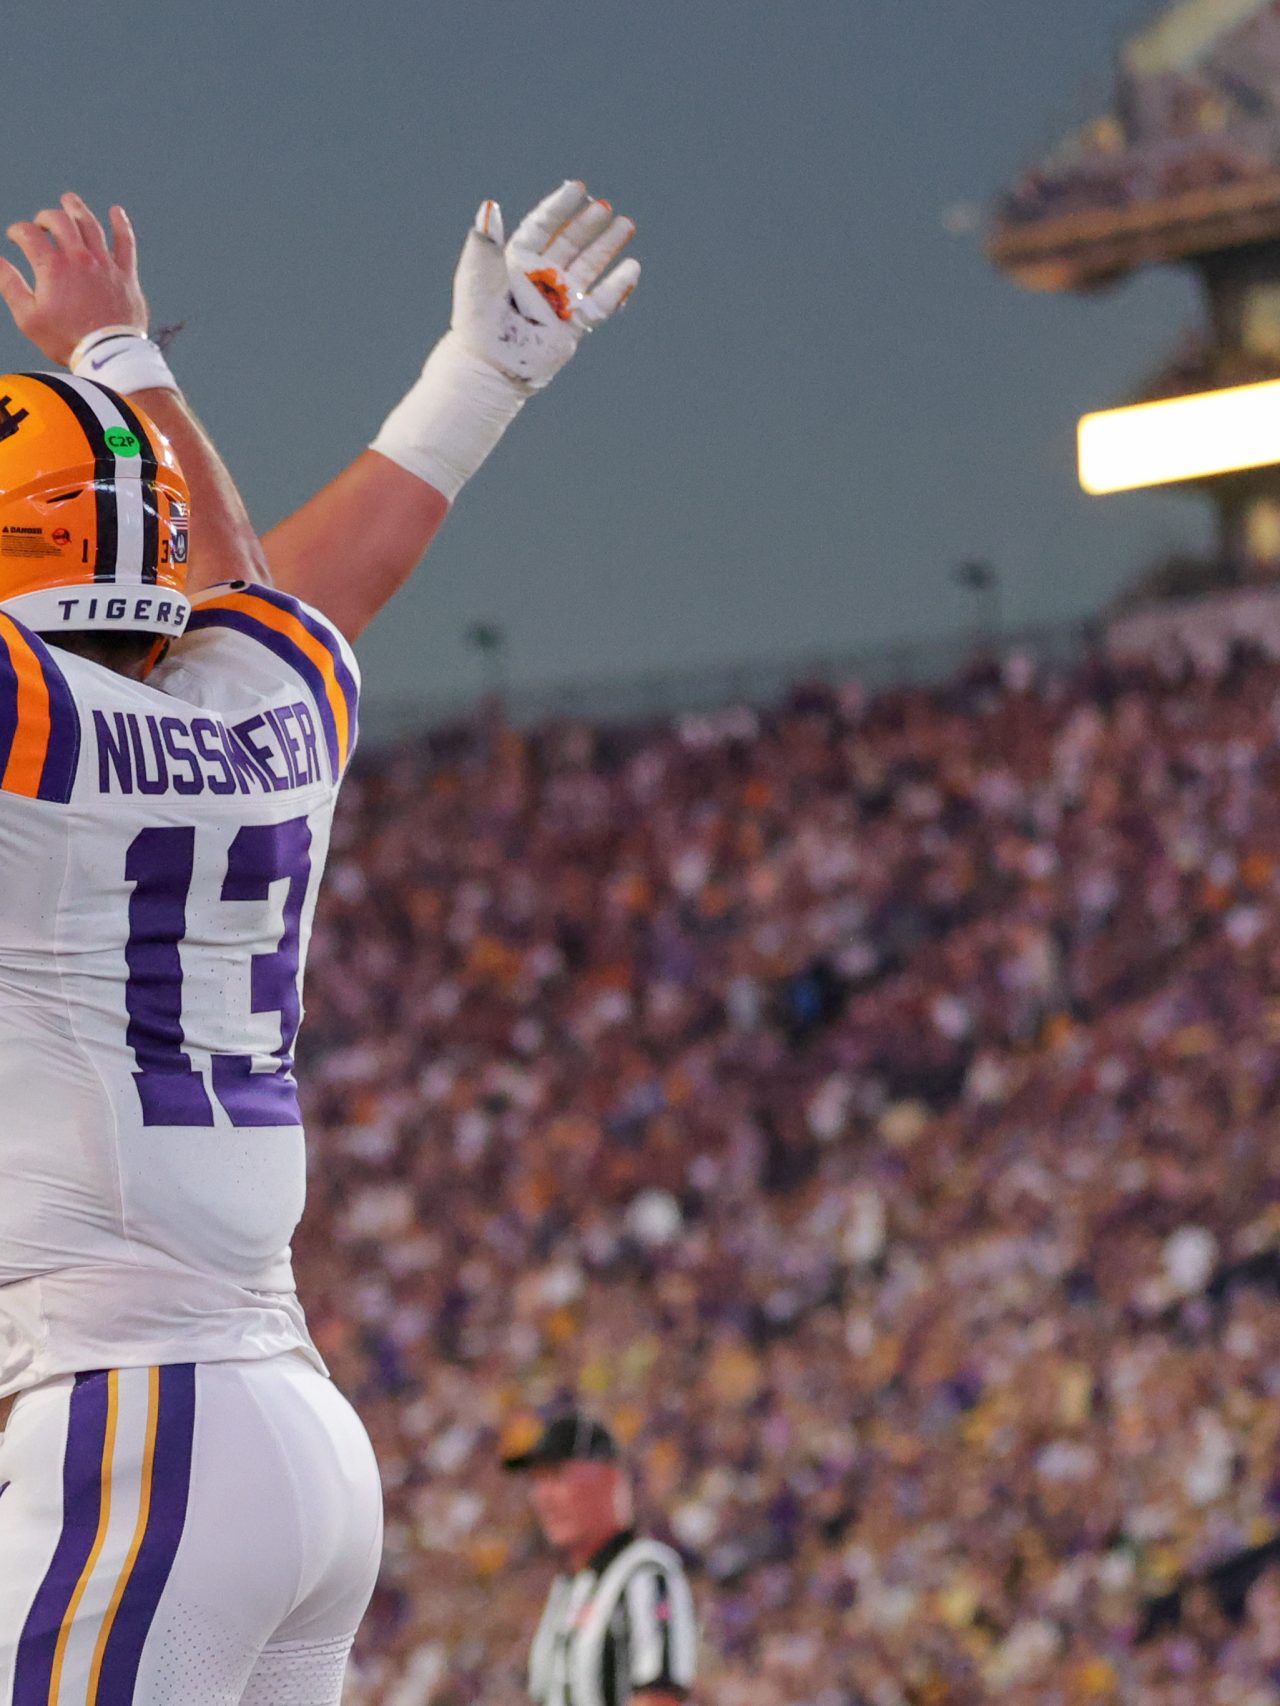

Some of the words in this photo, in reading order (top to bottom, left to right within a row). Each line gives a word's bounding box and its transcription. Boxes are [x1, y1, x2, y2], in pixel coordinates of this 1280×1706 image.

[107, 434, 136, 449] C2P
[58, 598, 187, 626] TIGERS
[91, 701, 321, 795] NUSSMEIER
[124, 814, 312, 1127] 13
